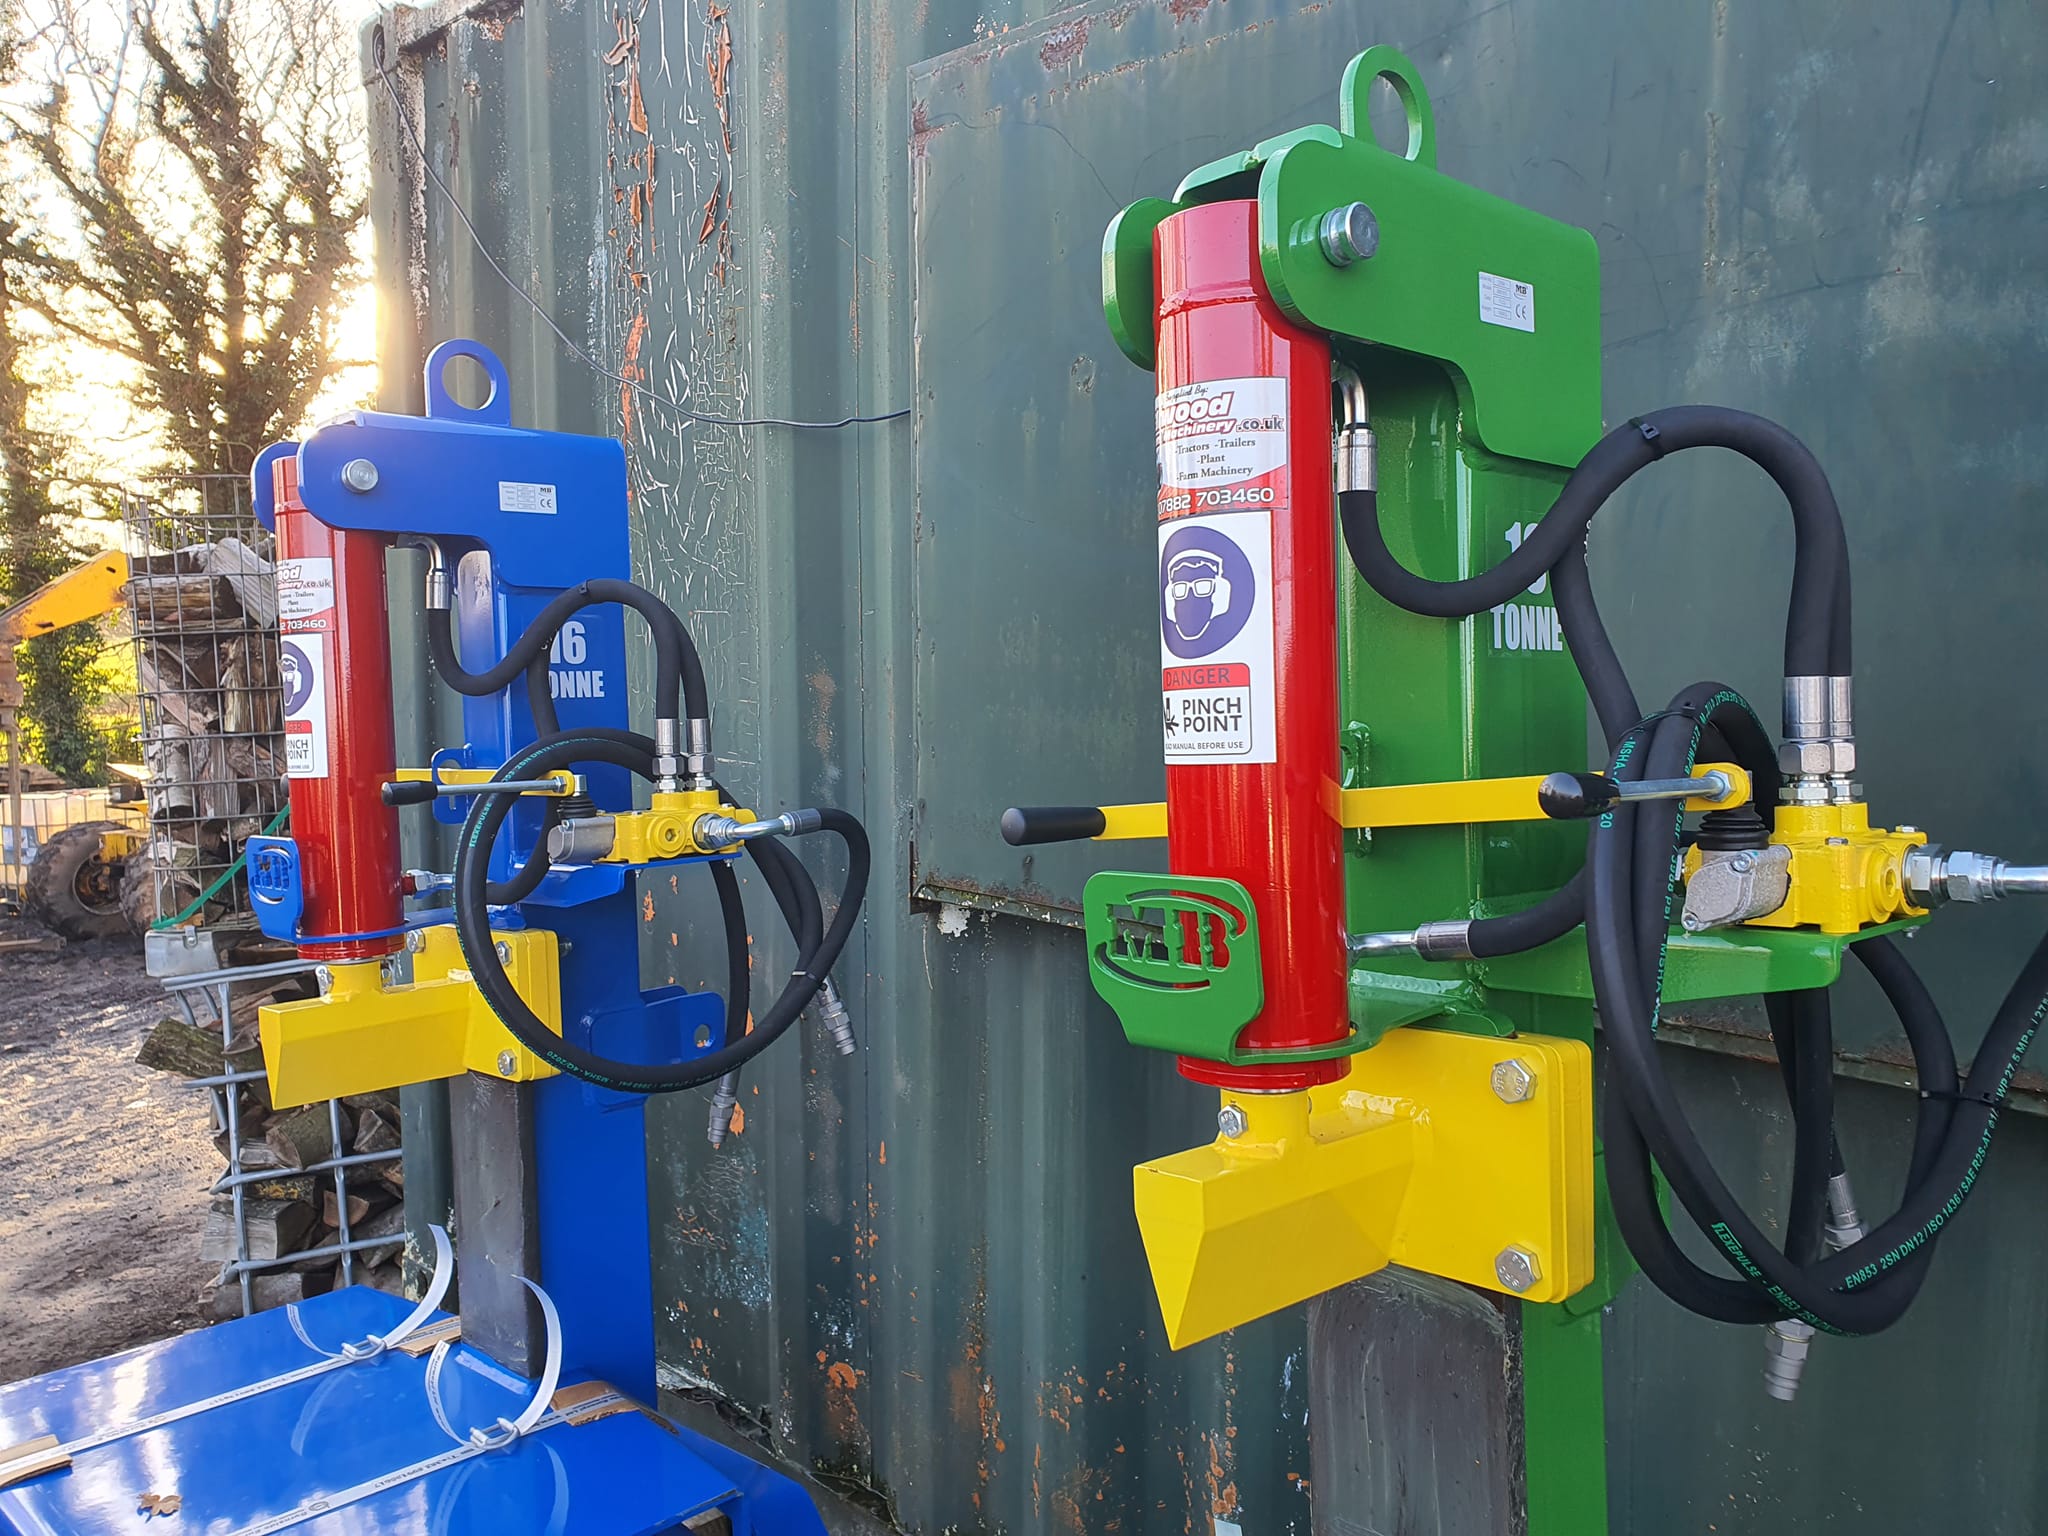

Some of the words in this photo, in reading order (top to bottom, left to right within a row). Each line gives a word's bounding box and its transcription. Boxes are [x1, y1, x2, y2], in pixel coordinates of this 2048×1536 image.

[1201, 466, 1254, 478] Machinery
[1196, 488, 1274, 507] 703460
[287, 619, 327, 629] 703460
[1490, 603, 1563, 651] TONNE
[549, 671, 605, 699] ONNE
[1166, 668, 1231, 687] DANGER
[1182, 697, 1242, 716] PINCH
[1183, 715, 1243, 733] POINT
[1197, 741, 1226, 750] BEFORE
[1228, 741, 1244, 749] USE
[1845, 1263, 1879, 1289] EN853
[1880, 1248, 1901, 1270] 2SN
